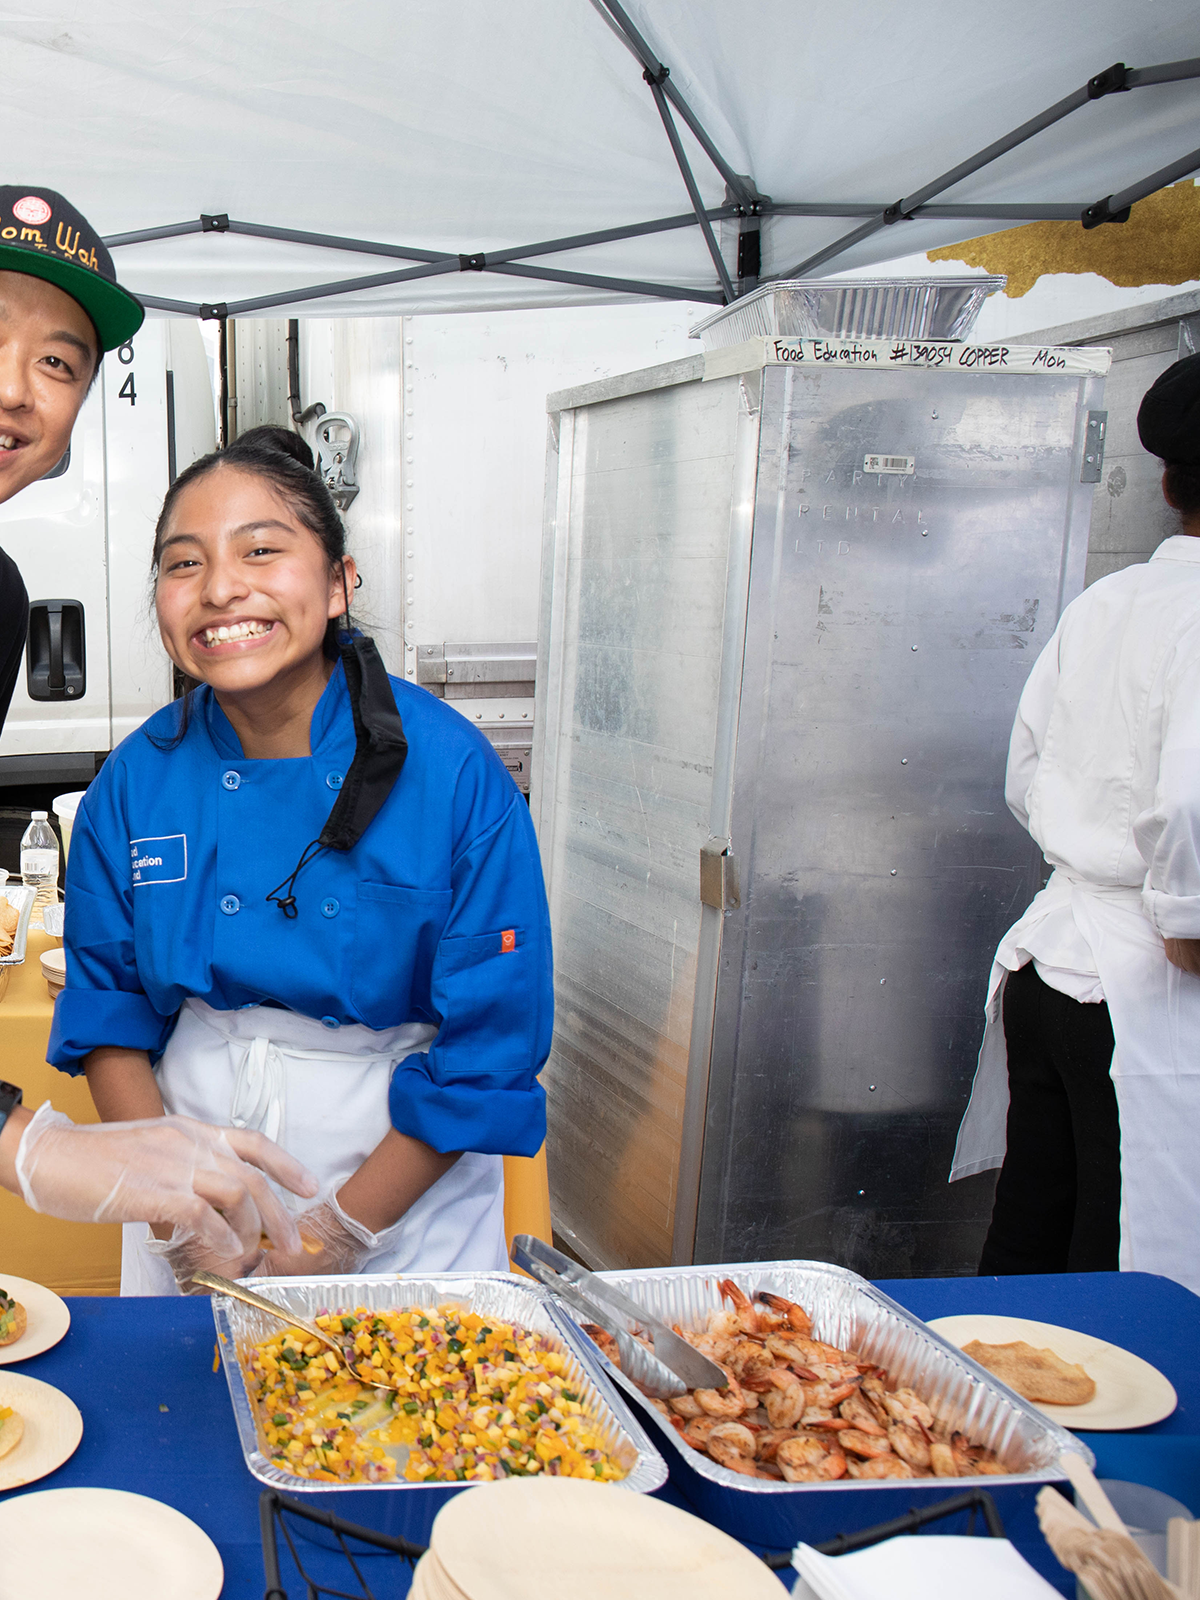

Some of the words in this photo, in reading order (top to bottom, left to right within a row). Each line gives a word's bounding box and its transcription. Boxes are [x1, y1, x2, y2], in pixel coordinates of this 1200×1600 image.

[56, 221, 99, 271] Wah
[773, 339, 804, 362] Food
[813, 340, 877, 362] Education
[958, 346, 1010, 367] COPPER
[1032, 350, 1066, 368] Mon
[794, 539, 850, 556] LTD
[132, 855, 162, 868] cation
